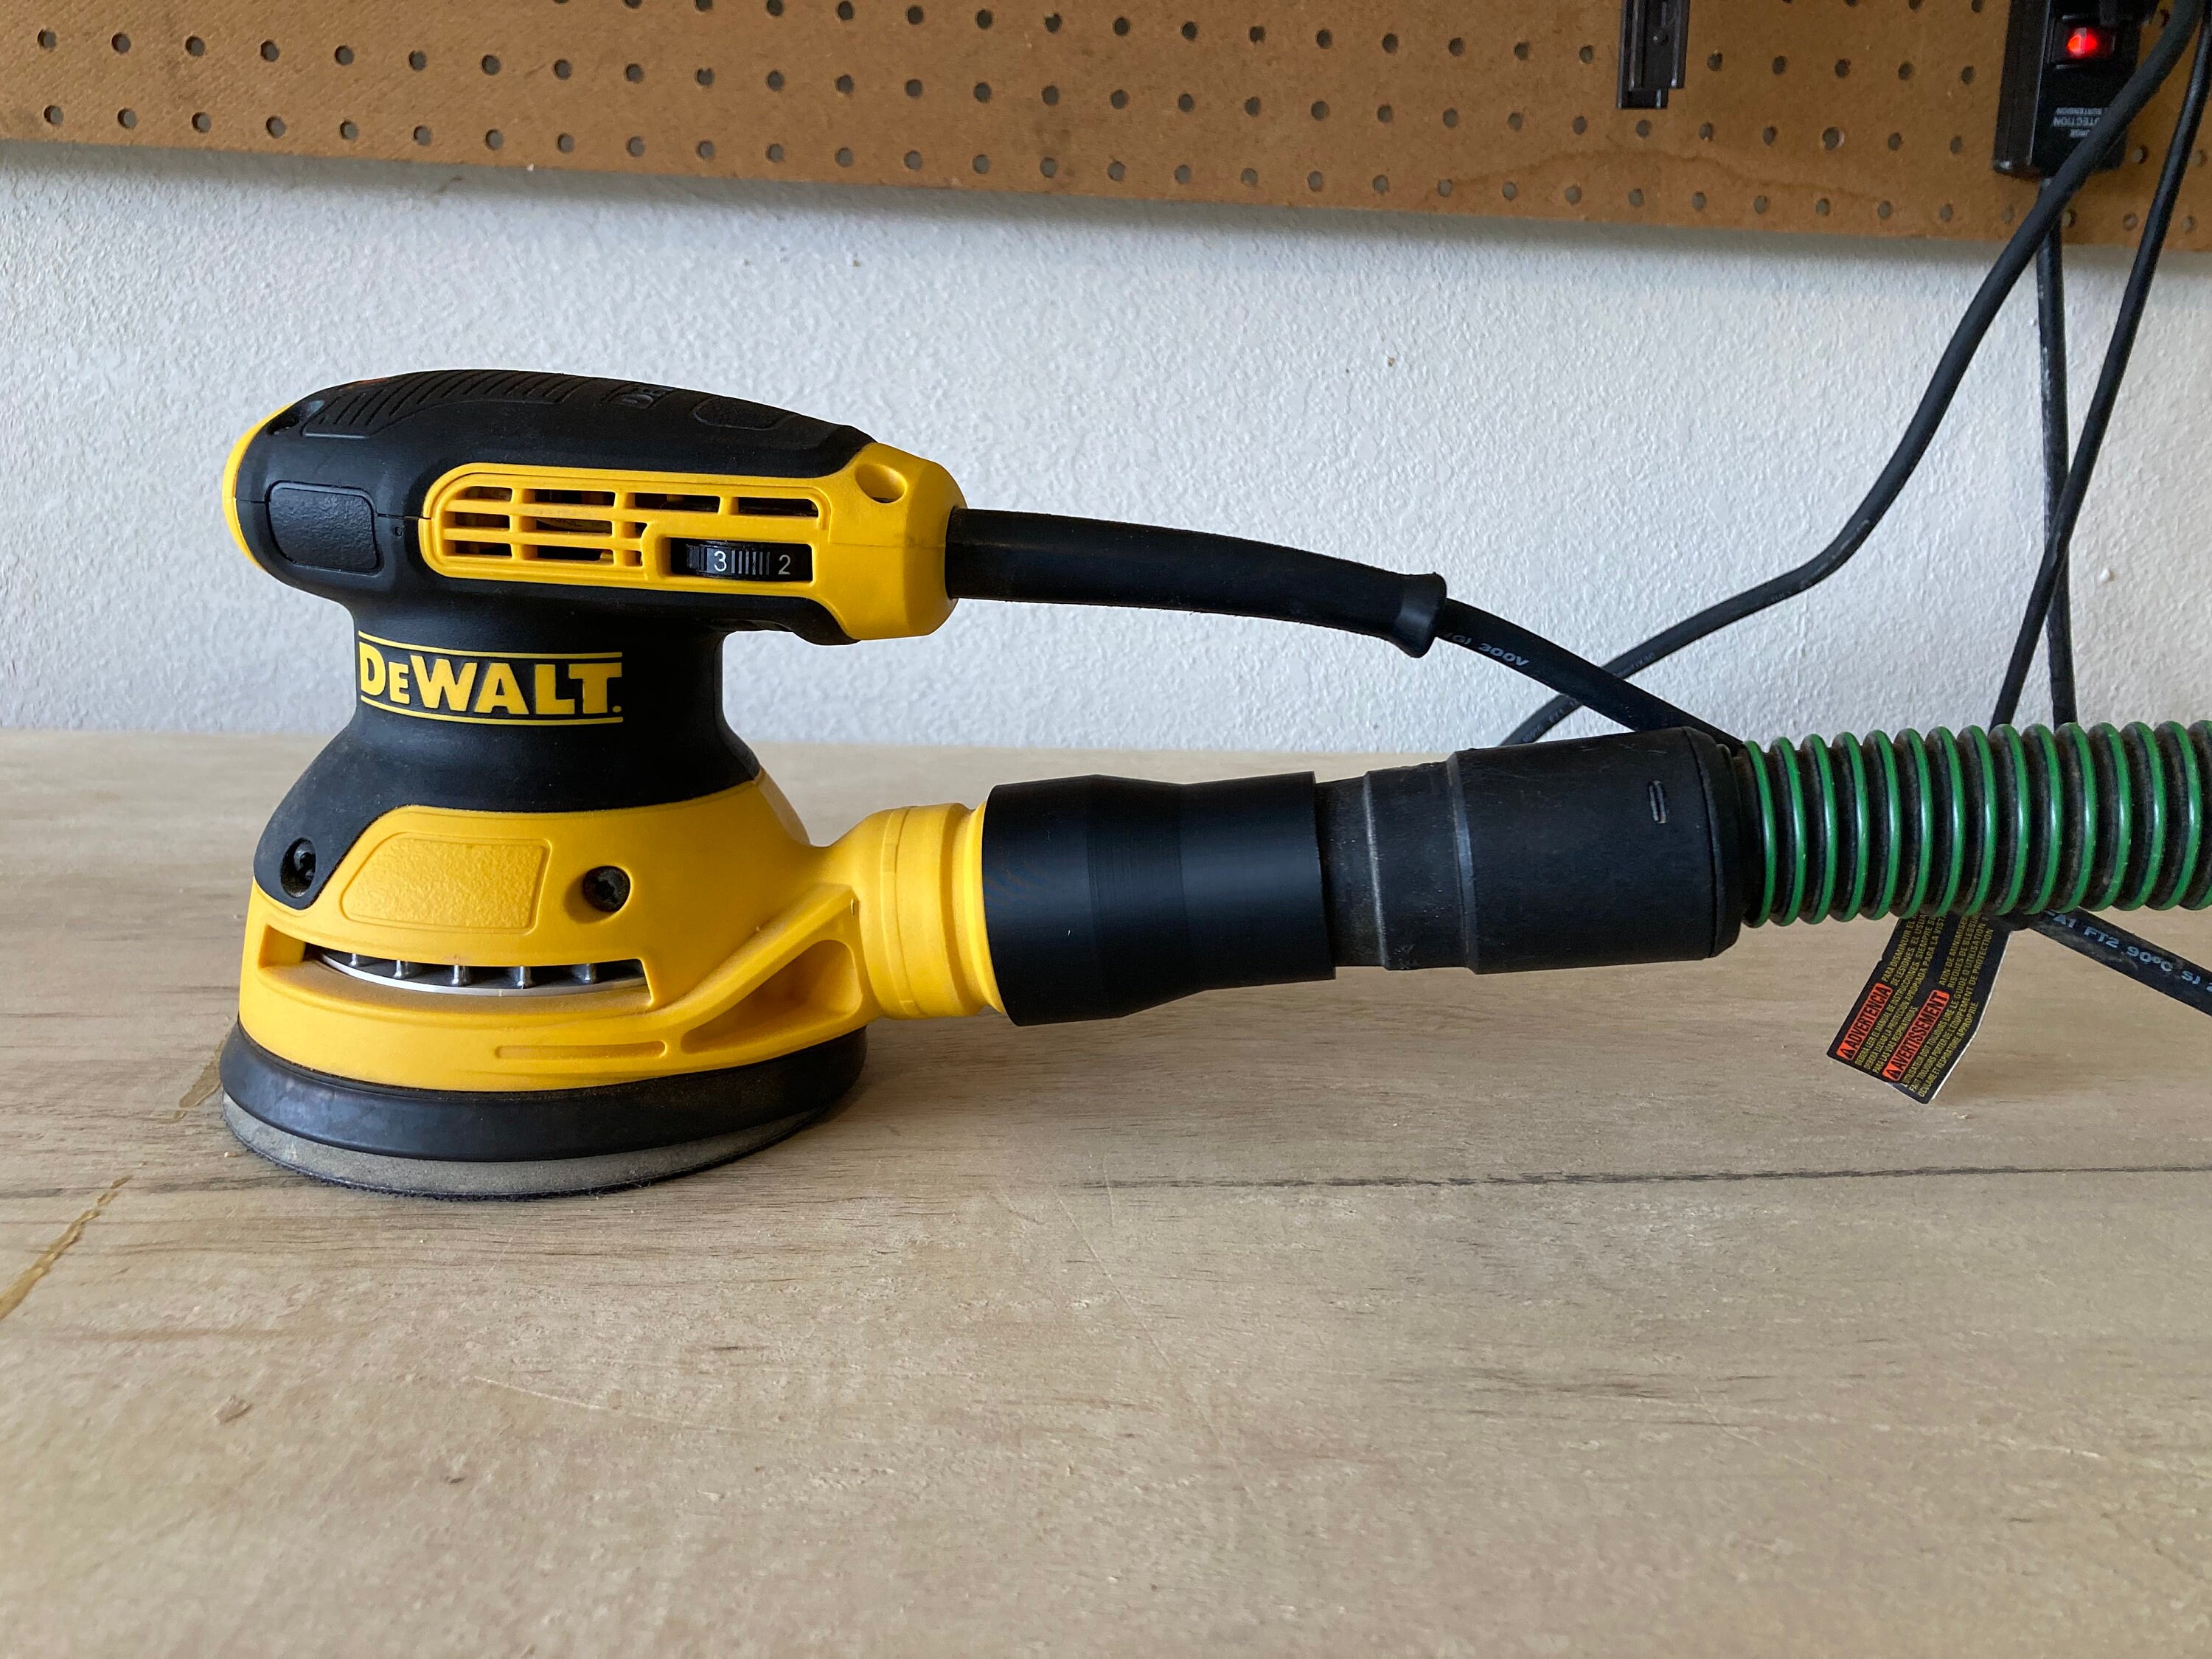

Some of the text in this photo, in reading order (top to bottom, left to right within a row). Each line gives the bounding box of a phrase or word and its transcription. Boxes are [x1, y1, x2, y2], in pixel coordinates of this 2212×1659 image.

[713, 550, 791, 575] 3 2
[1478, 643, 1530, 667] 300V
[1881, 966, 1894, 981] PARA
[1889, 929, 1911, 967] DISMINUIR
[1972, 928, 1994, 973] PROTECTION
[2083, 926, 2120, 949] FT2
[2181, 970, 2201, 985] SJ
[1938, 968, 1950, 985] AFIN
[1945, 956, 1954, 967] DE
[1947, 958, 1964, 987] RISQUES
[1958, 945, 1967, 956] DE
[1865, 1036, 1877, 1048] LEER
[1874, 1012, 1891, 1032] MANUAL
[1886, 1004, 1896, 1012] DE
[1915, 926, 1933, 959] SIEMPRE
[1890, 976, 1900, 985] DE
[1953, 975, 1967, 998] GUIDE
[1969, 975, 1978, 984] DE
[1874, 1035, 1888, 1051] LLEVAR
[1904, 968, 1927, 1001] APROPIADA
[1922, 946, 1935, 965] PARA
[1930, 936, 1938, 945] LA
[1949, 1000, 1959, 1008] LE
[1844, 986, 1891, 1049] ADVERTENCIA
[1941, 1007, 1955, 1020] LIRE
[1890, 990, 1947, 1071] AVERTISSEMENT
[1926, 1020, 1947, 1046] TOUJOURS
[1942, 1031, 1952, 1039] DE
[1919, 1044, 1931, 1057] DOIT
[1931, 1038, 1947, 1057] PORTER
[1872, 1060, 1885, 1073] PARA
[1879, 1051, 1890, 1061] LAS
[1916, 1055, 1936, 1079] TOUJOURS
[1917, 1073, 1937, 1096] OCULAIRE
[1935, 1036, 1961, 1068] RESPIRATOIRE
[1908, 1078, 1921, 1092] FAUT
